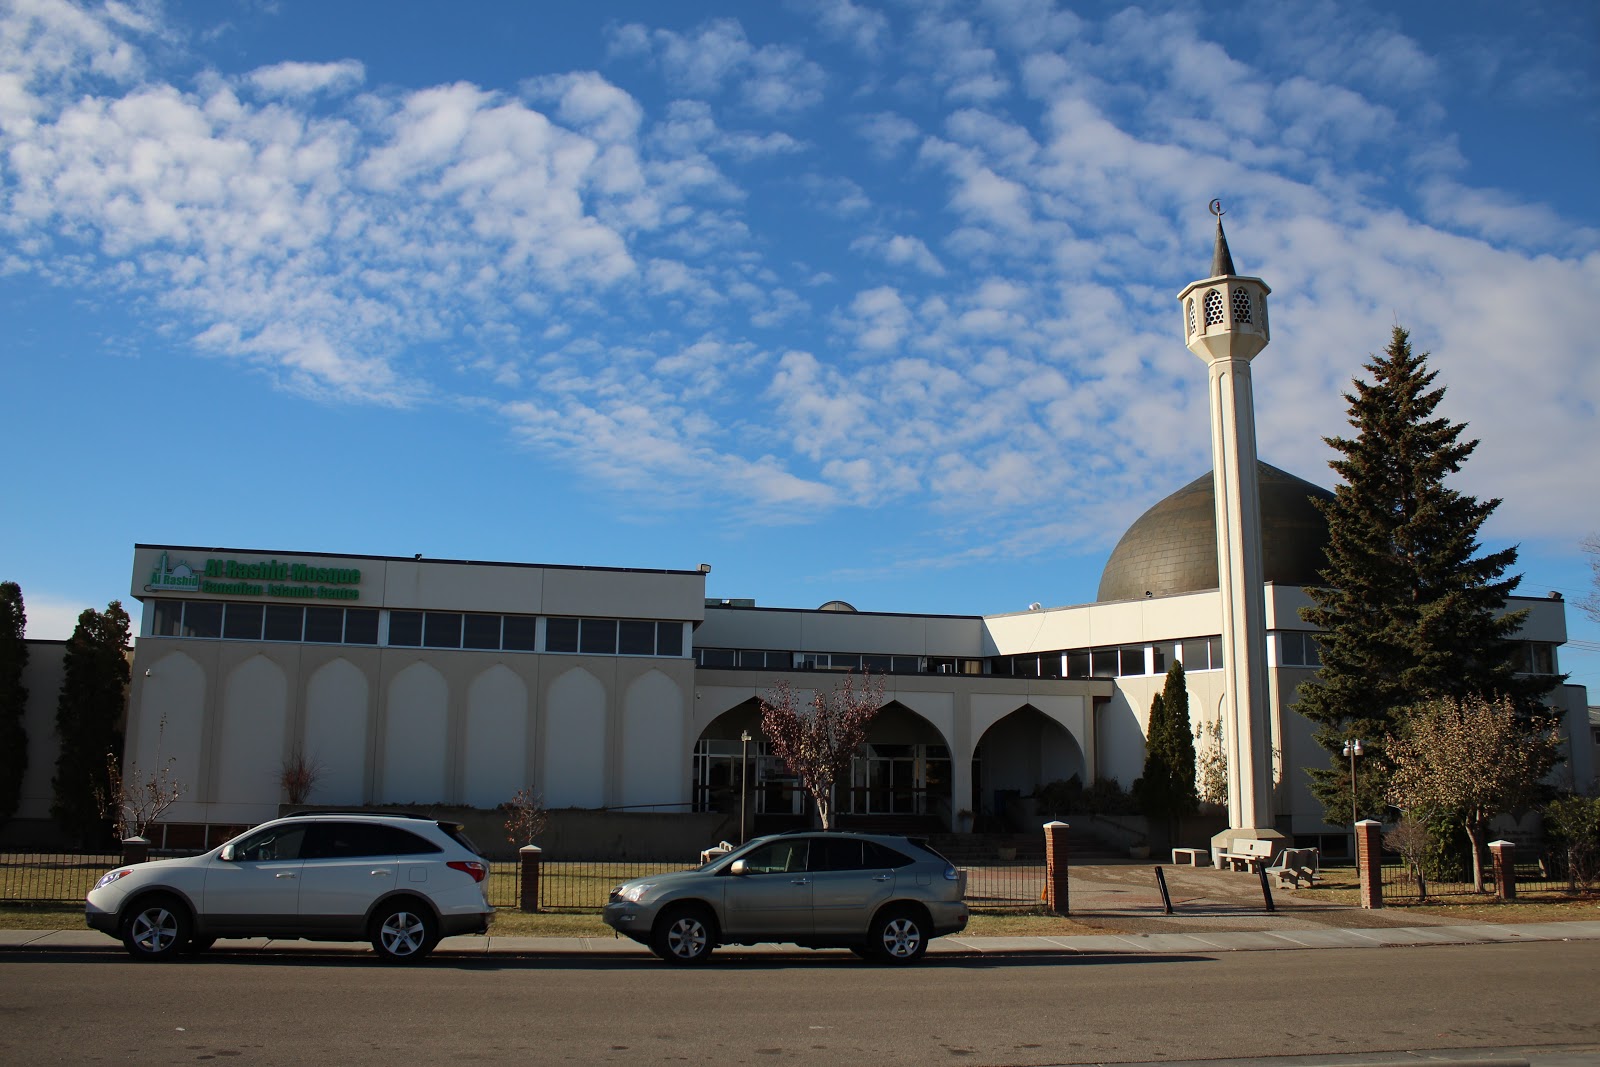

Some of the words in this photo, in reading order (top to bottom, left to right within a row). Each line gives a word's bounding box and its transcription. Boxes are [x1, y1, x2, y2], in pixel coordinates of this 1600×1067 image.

[151, 572, 161, 585] Al
[163, 574, 198, 586] Rashid
[204, 558, 223, 577] Al
[226, 559, 289, 581] Rashid
[291, 563, 361, 585] Mosque
[202, 579, 264, 596] Canadian
[267, 583, 316, 598] Islamic
[317, 585, 360, 600] Centre
